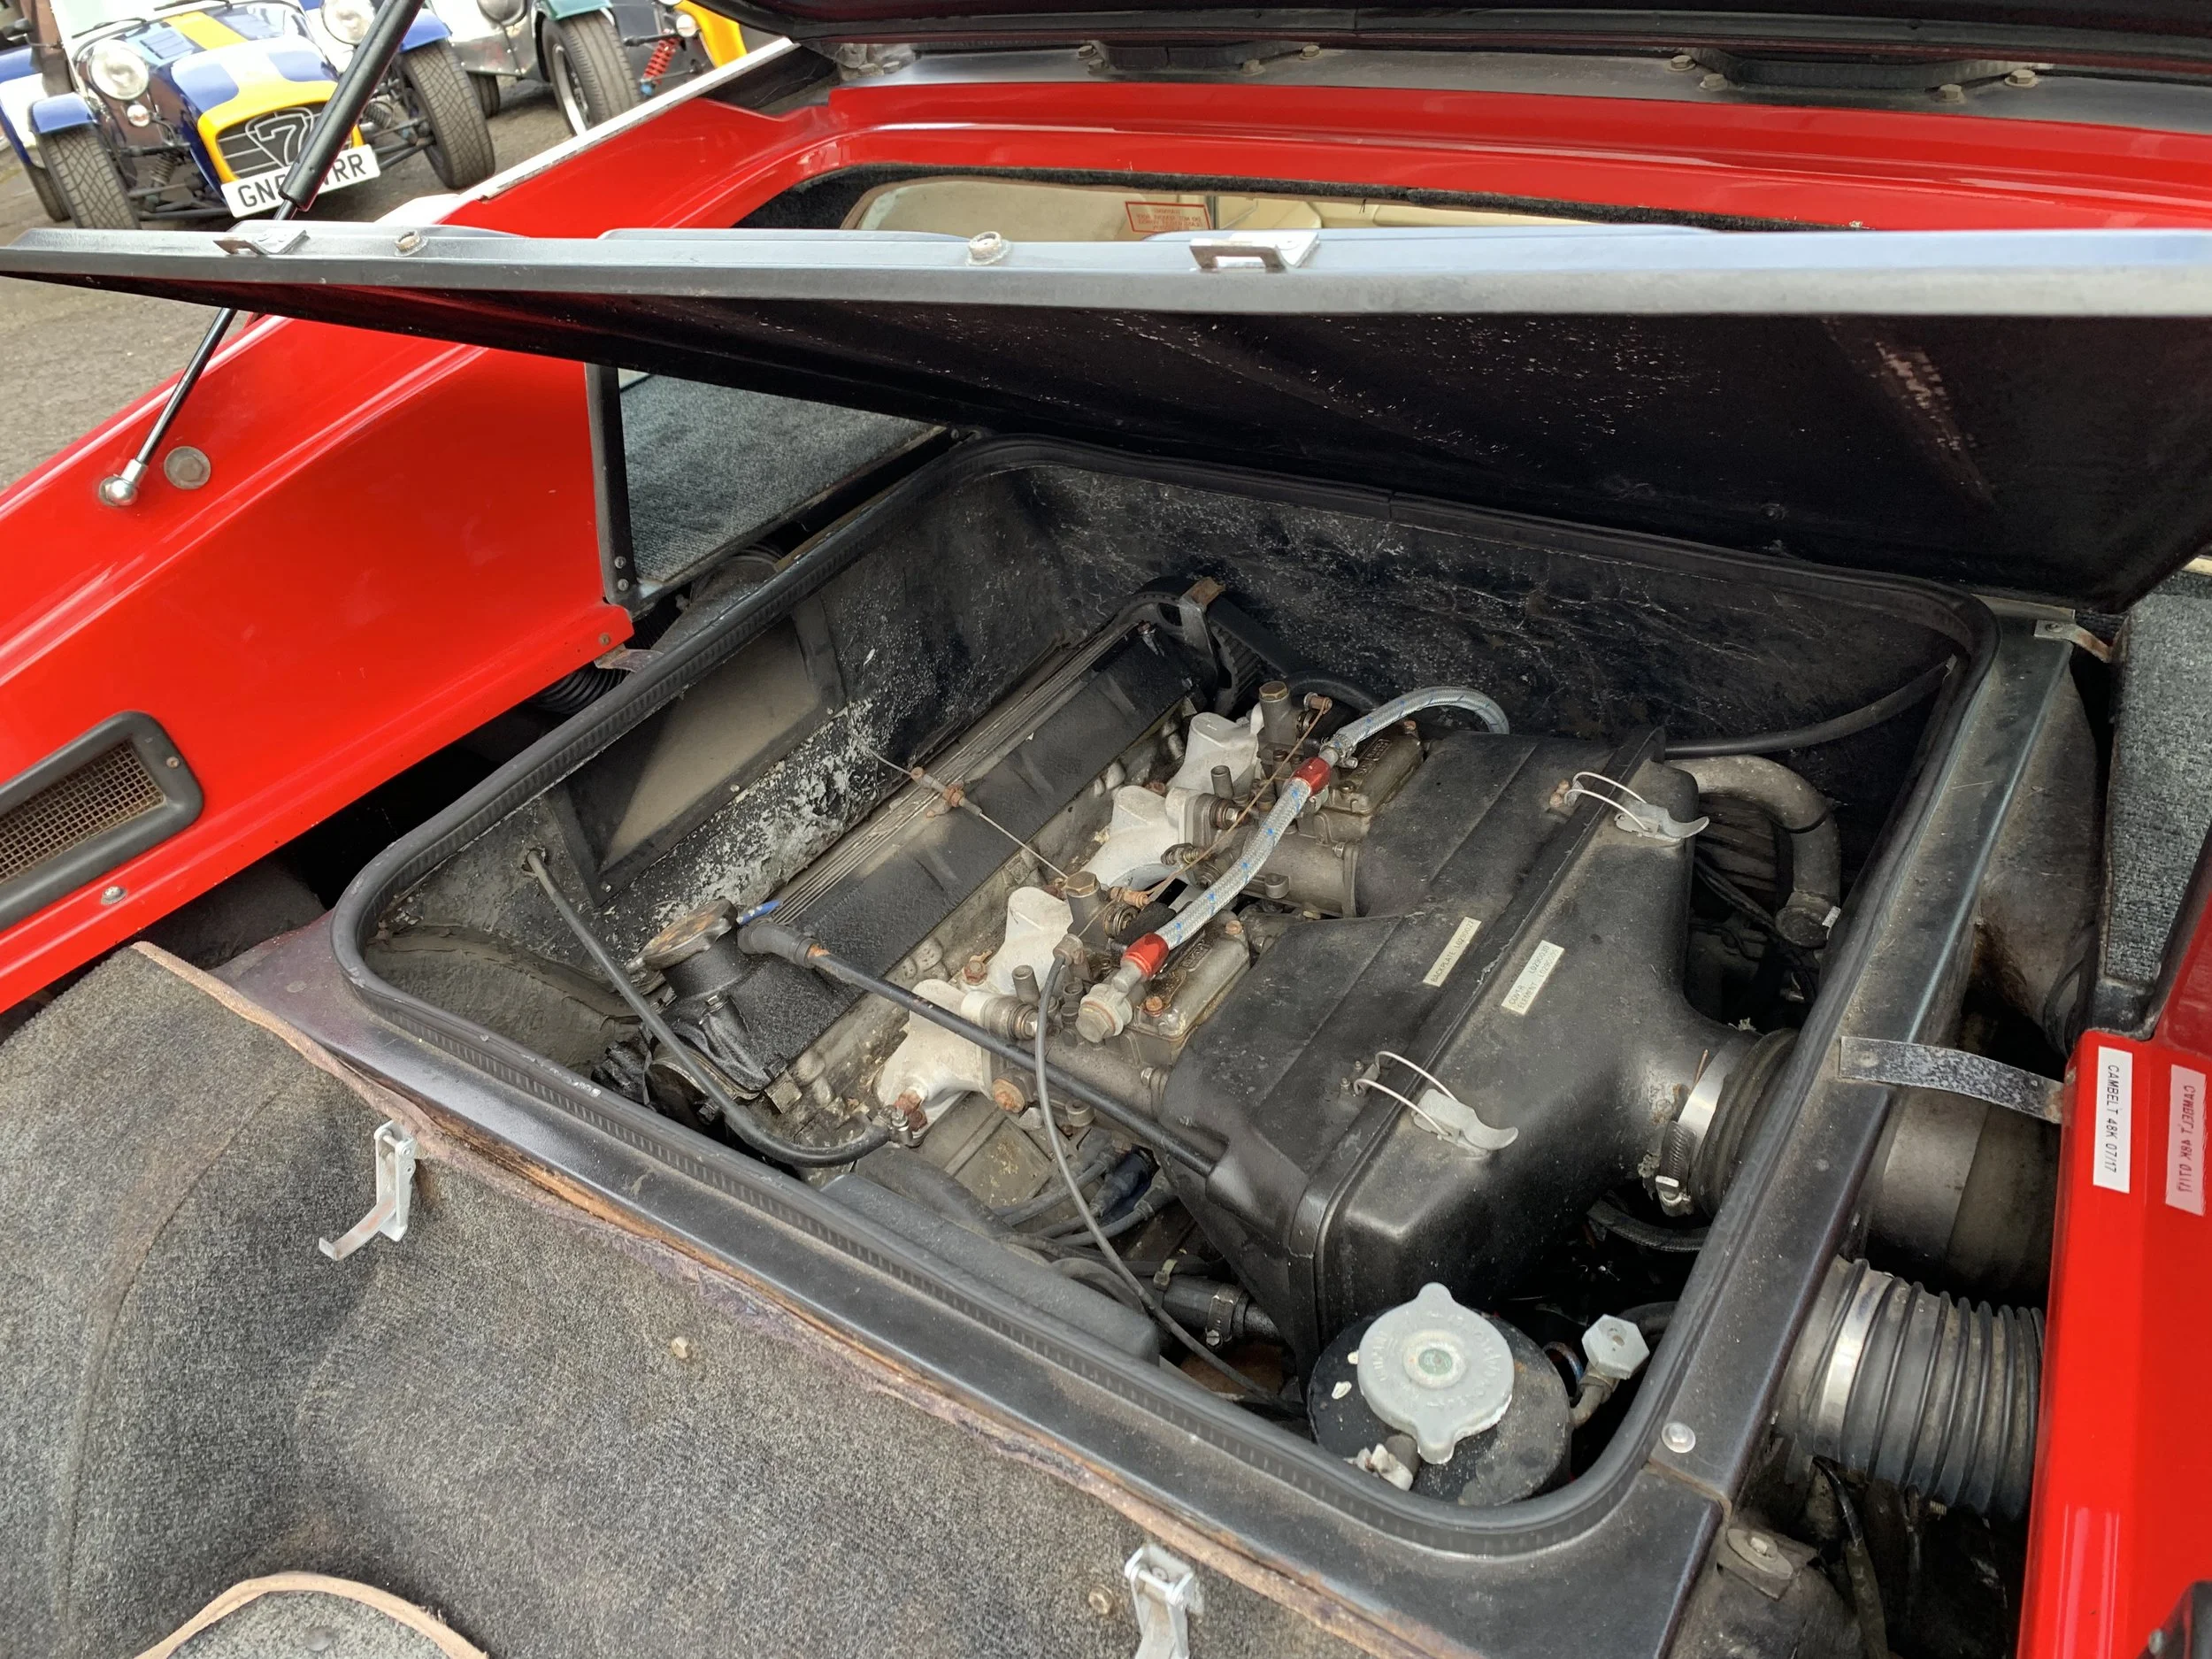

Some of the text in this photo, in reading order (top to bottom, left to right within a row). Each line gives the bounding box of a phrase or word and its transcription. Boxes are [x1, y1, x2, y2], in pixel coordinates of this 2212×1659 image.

[323, 152, 367, 187] RR
[2104, 1064, 2119, 1174] CAMBELT 48K 07/17
